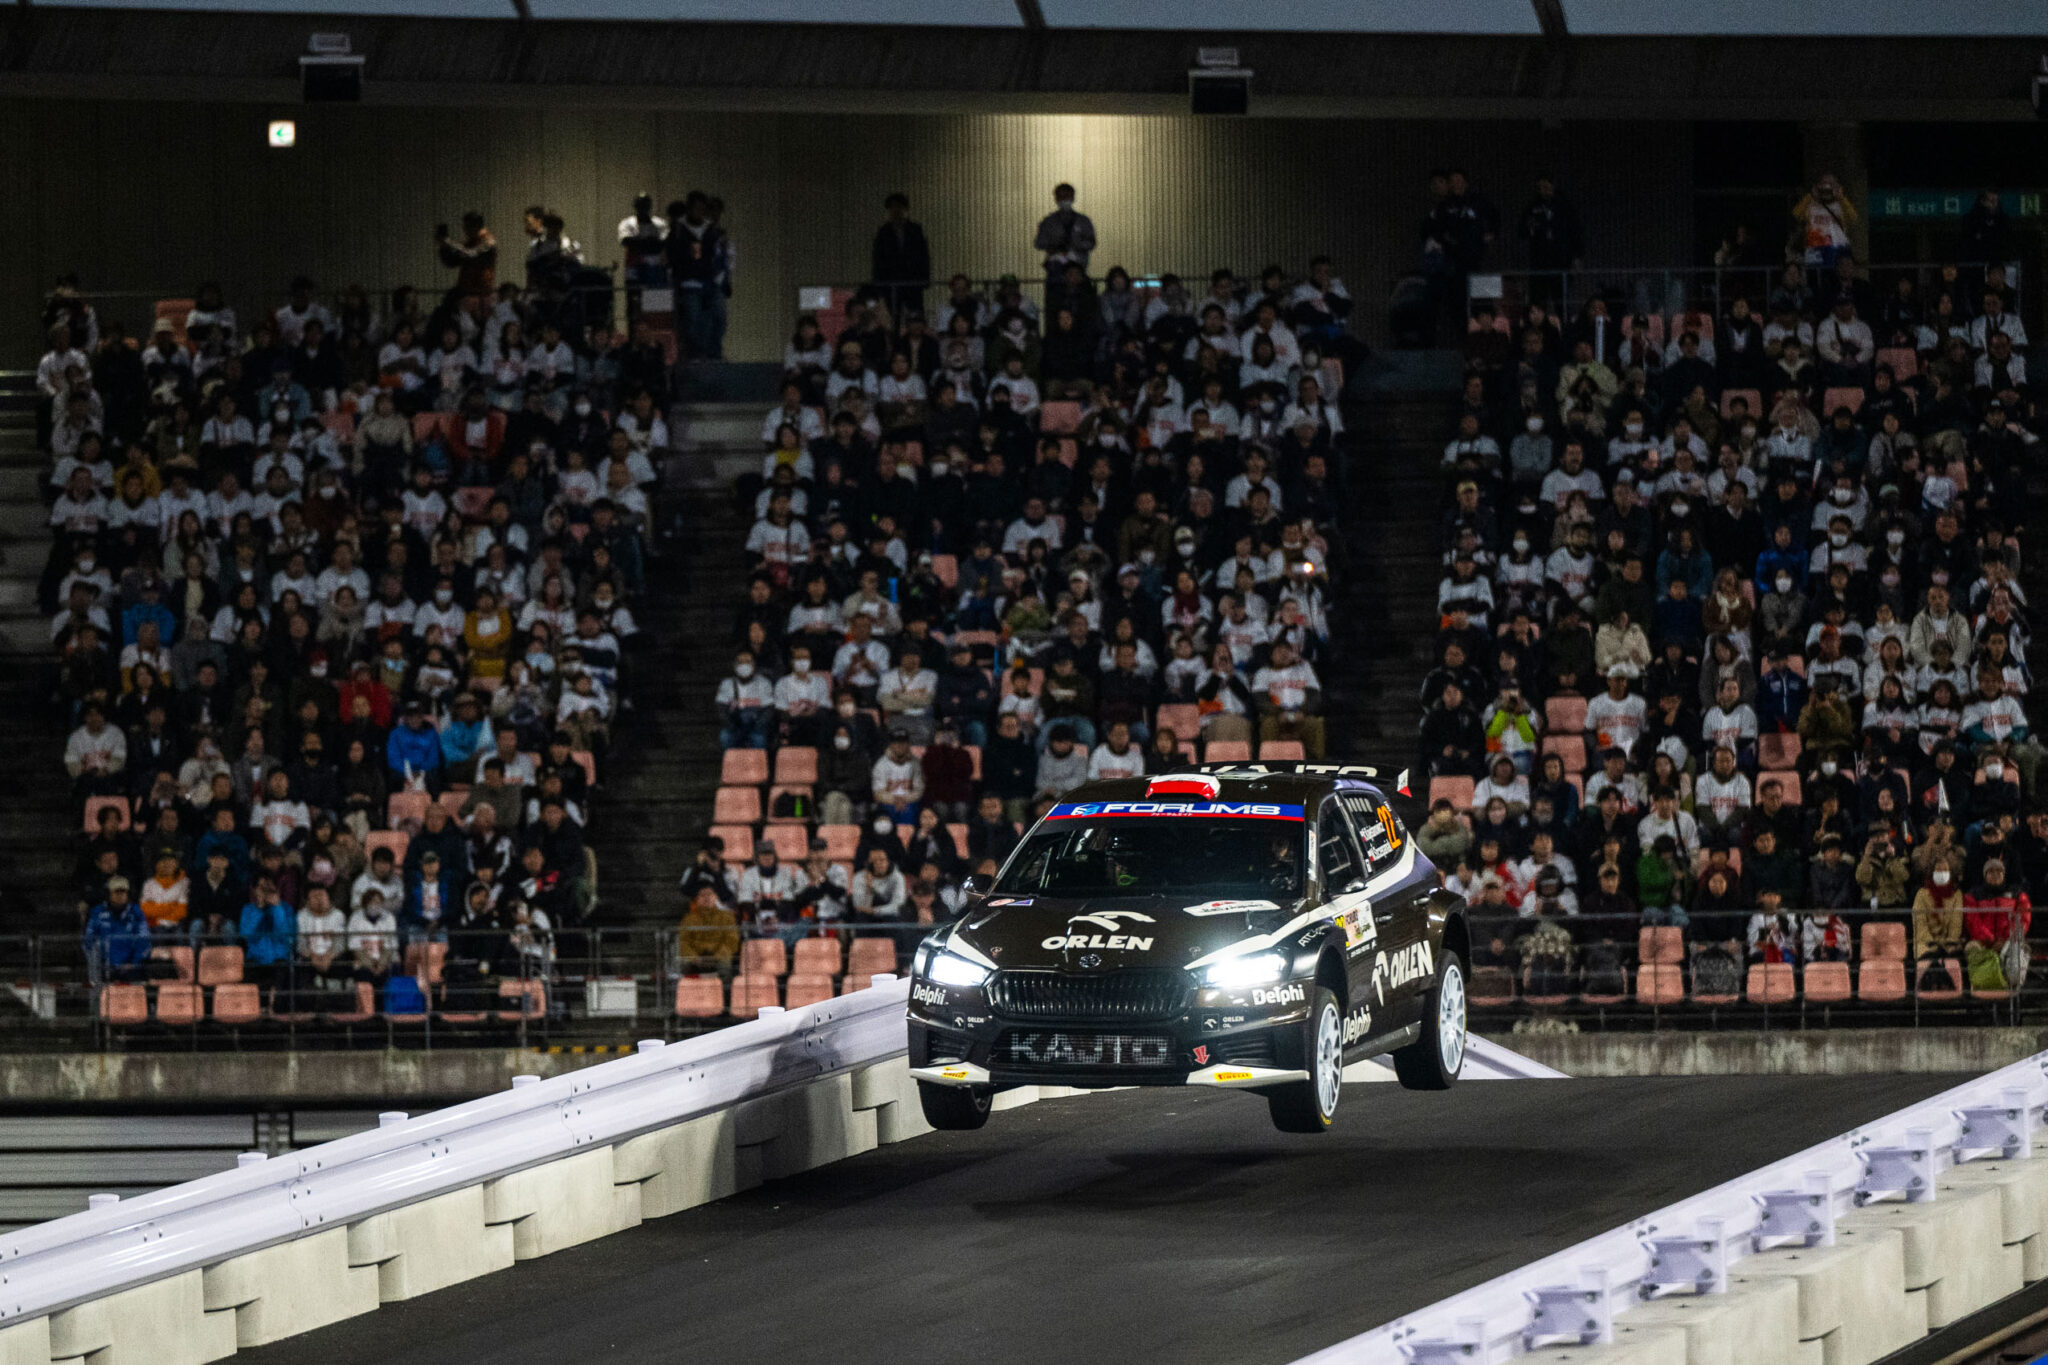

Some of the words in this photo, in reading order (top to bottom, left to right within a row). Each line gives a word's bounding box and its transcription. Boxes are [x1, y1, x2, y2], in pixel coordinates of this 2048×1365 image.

[1102, 803, 1281, 816] FORUM8
[1041, 934, 1154, 951] ORLEN
[1390, 939, 1434, 989] ORLEN
[912, 983, 946, 1006] Delphi
[1252, 983, 1306, 1006] Delphi
[967, 1016, 985, 1024] ORLEN
[1342, 1004, 1372, 1045] Delphi
[1011, 1033, 1168, 1063] KAJTO
